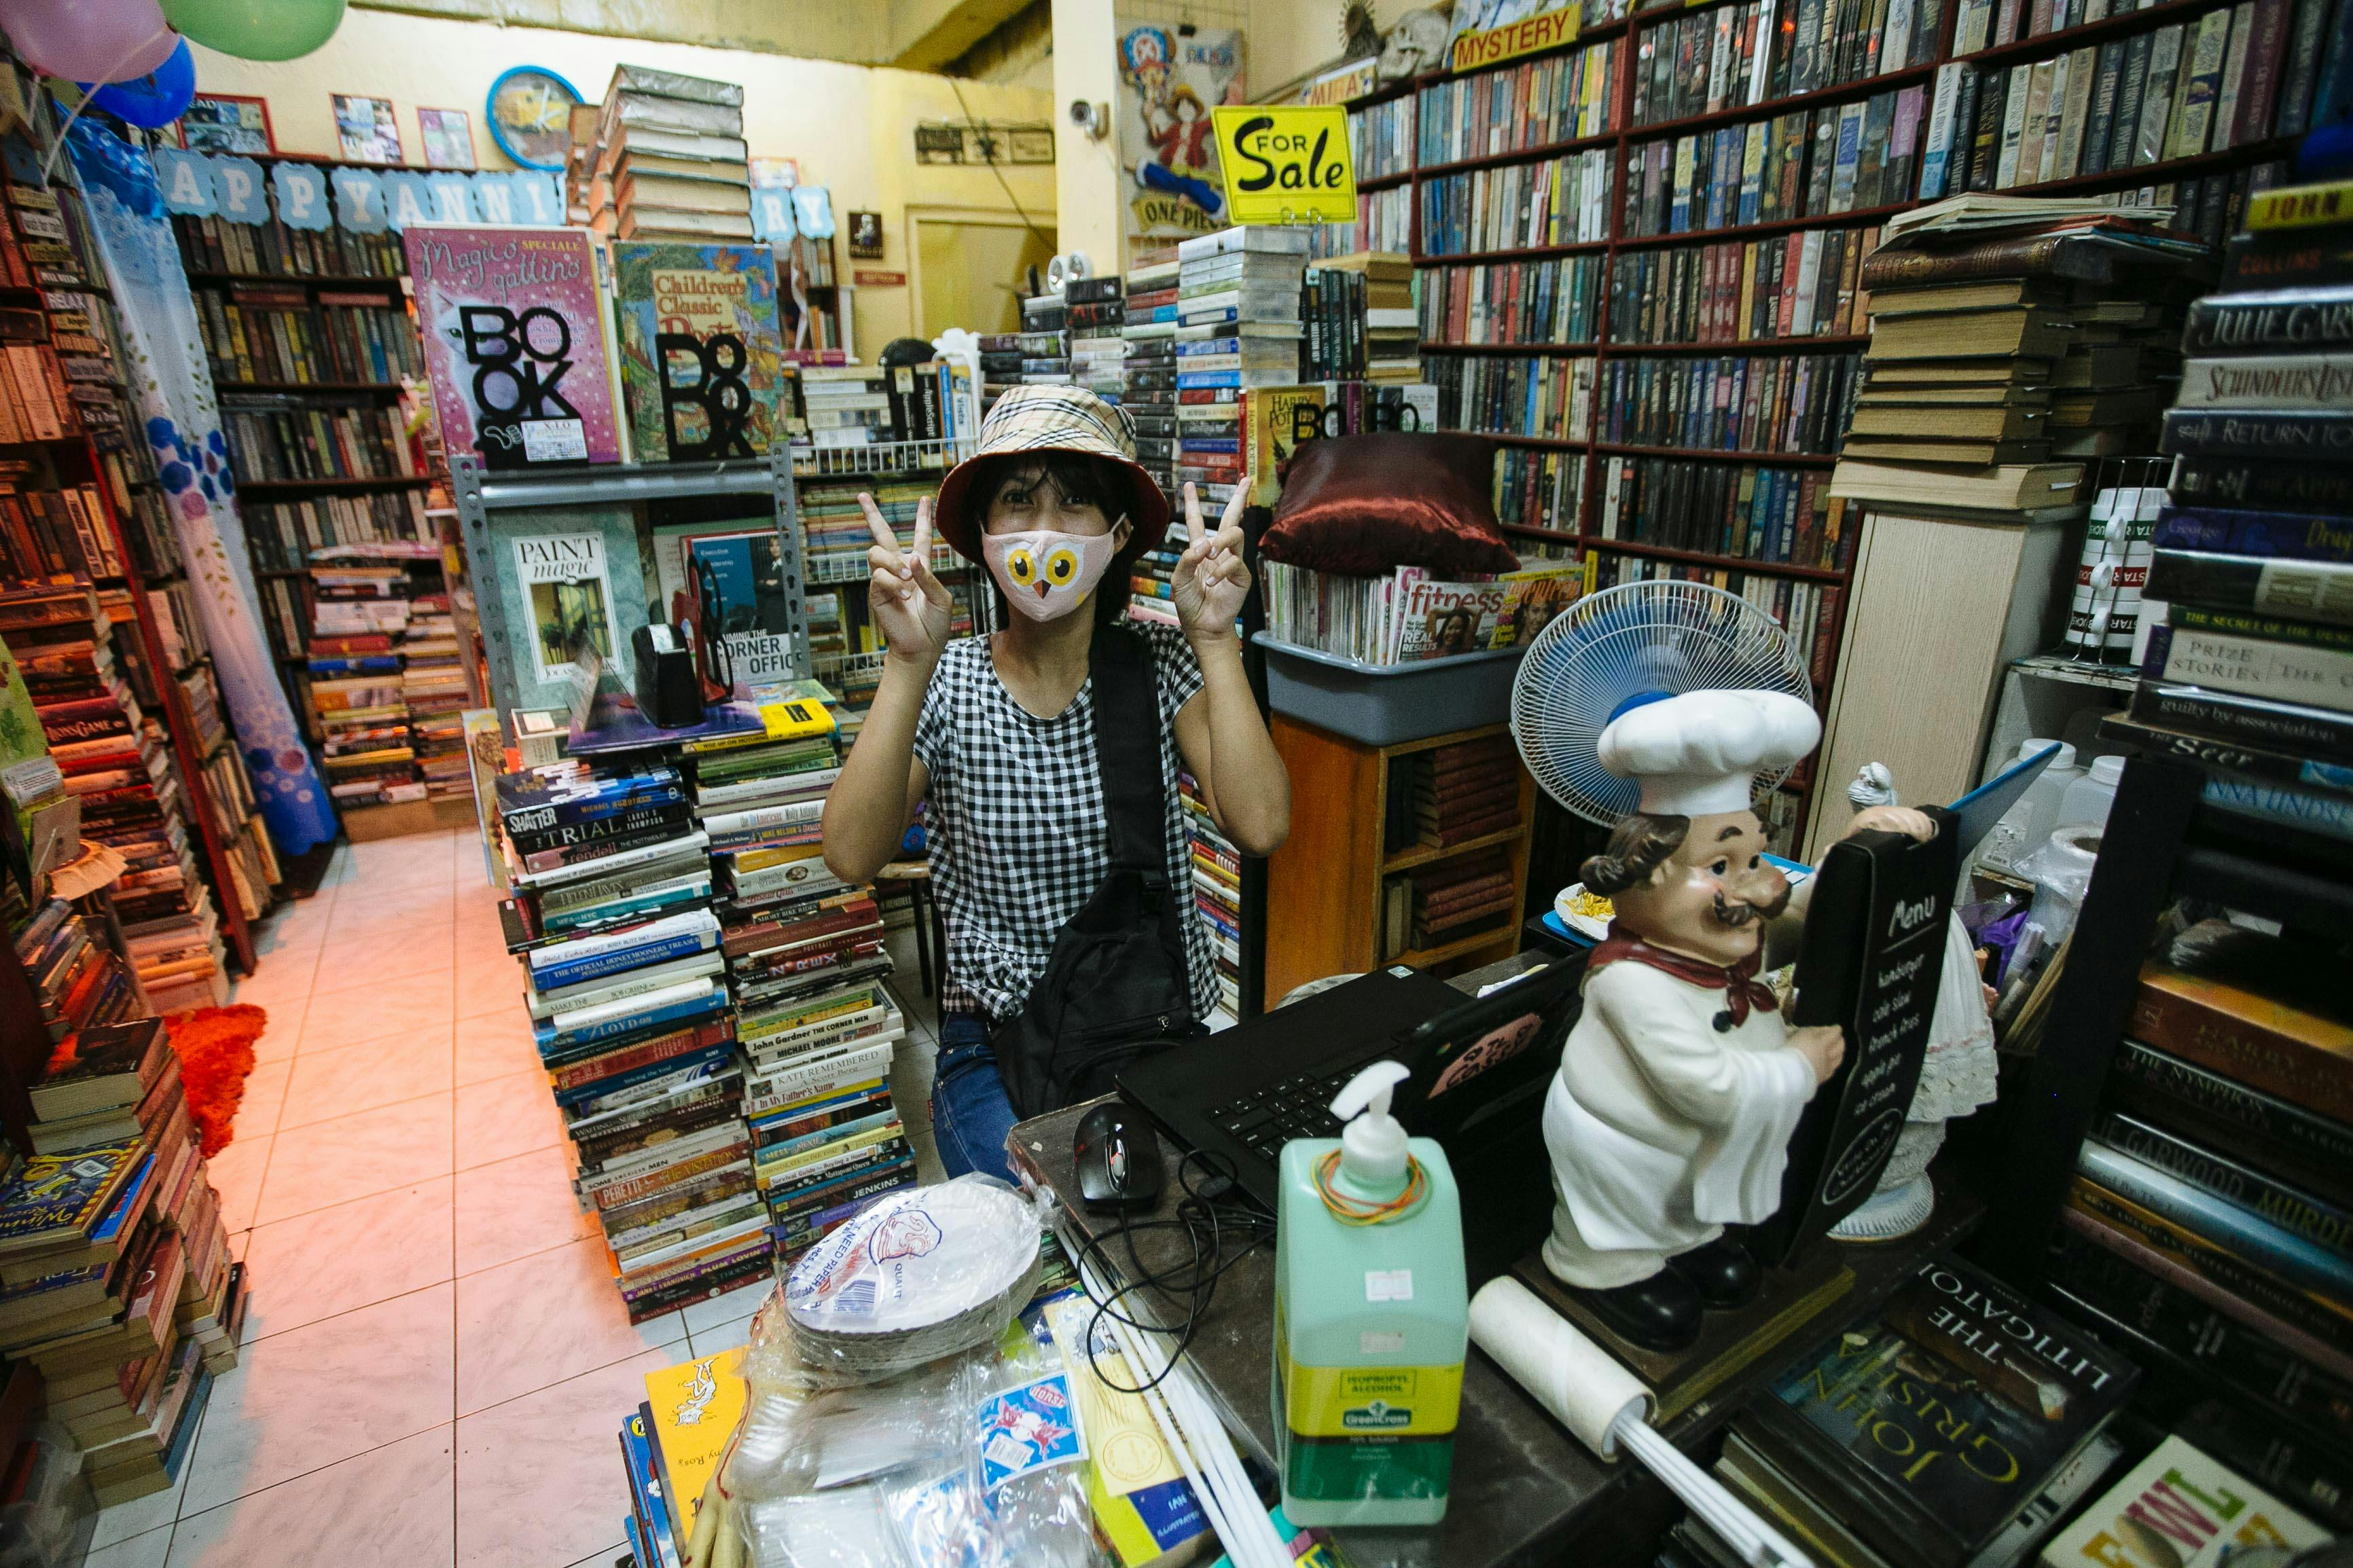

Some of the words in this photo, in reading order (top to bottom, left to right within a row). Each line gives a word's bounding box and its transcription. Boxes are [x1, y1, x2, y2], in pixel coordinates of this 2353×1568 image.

[1456, 10, 1569, 65] MYSTERY
[1234, 117, 1344, 192] Sale
[1257, 134, 1307, 152] FOR
[1182, 206, 1227, 230] PIEC
[418, 238, 517, 289] Magico
[492, 255, 580, 306] gattino
[654, 274, 746, 295] Children's
[658, 297, 721, 316] Classic
[920, 388, 937, 437] AppleScript
[520, 536, 601, 566] PAINT
[534, 558, 594, 585] magic
[1410, 584, 1505, 615] fitness
[1402, 643, 1437, 652] RESULTS
[1404, 632, 1433, 643] REAL
[2190, 642, 2252, 662] PRIZE
[509, 807, 558, 833] SHATTER
[543, 818, 622, 846] TRIAL
[627, 816, 664, 831] THOMPSON
[761, 828, 775, 838] MIKE
[570, 842, 617, 863] rendell
[781, 909, 797, 917] BIKE
[797, 905, 817, 913] RIDES
[554, 969, 570, 978] THE
[571, 960, 607, 974] OFFICIAL
[607, 945, 667, 966] HONEYMOONERS
[753, 1040, 774, 1051] John
[775, 1031, 810, 1044] Gardner
[826, 1020, 853, 1030] CORNER
[854, 1015, 869, 1023] MEN
[776, 1044, 811, 1058] MICHAEL
[813, 1036, 841, 1048] MOORE
[777, 1072, 806, 1084] KATE
[808, 1051, 878, 1076] REMEMBERED
[759, 1099, 768, 1109] In
[769, 1096, 781, 1106] My
[782, 1087, 813, 1101] Father's
[814, 1082, 835, 1094] Name
[588, 1178, 613, 1190] SOME
[648, 1159, 668, 1169] MEN
[772, 1173, 797, 1185] Survival
[797, 1167, 816, 1178] Guide
[823, 1158, 844, 1169] Buying
[850, 1151, 867, 1160] Home
[852, 1161, 870, 1171] Queen
[603, 1178, 642, 1201] PERETTI
[852, 1177, 899, 1199] JENKINS
[635, 1283, 658, 1298] JANET
[700, 1261, 729, 1274] PLUM
[731, 1248, 762, 1264] LOVIN'
[1168, 1493, 1187, 1511] IAN
